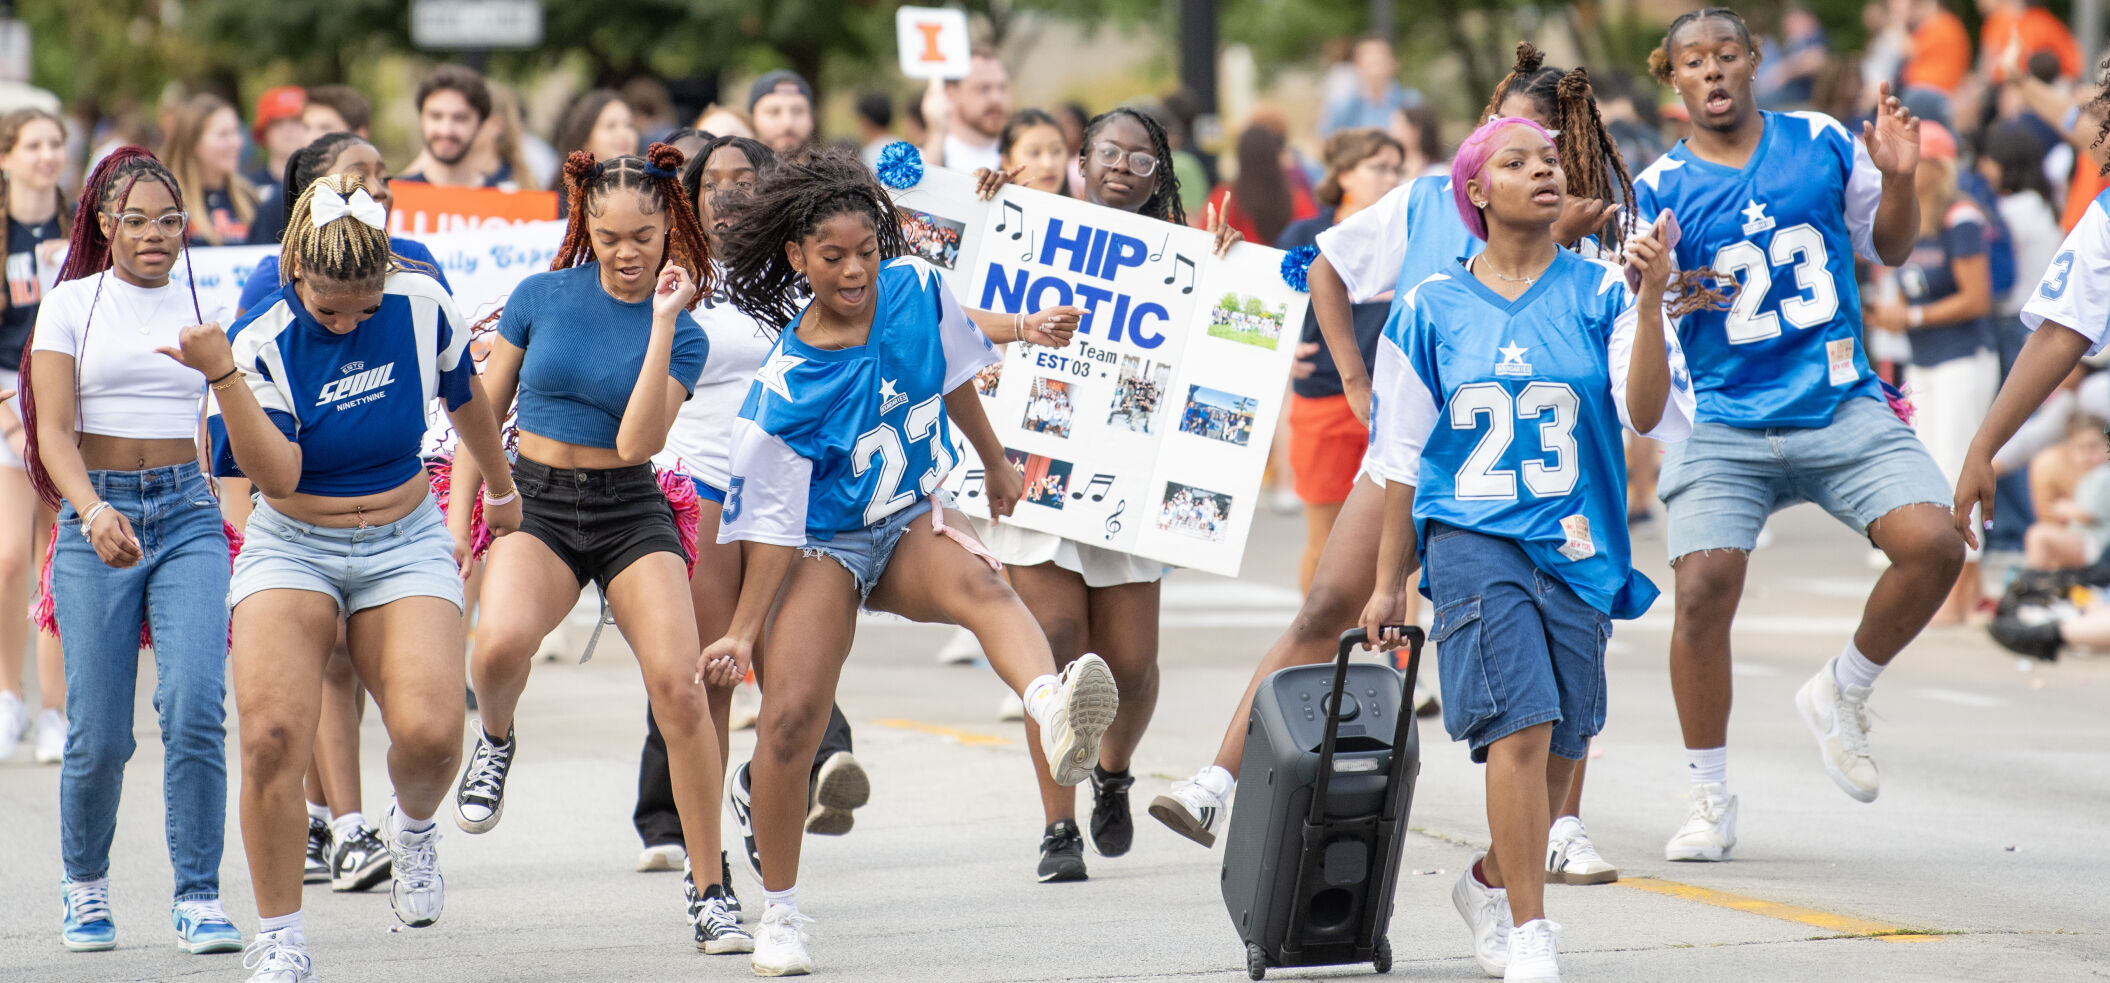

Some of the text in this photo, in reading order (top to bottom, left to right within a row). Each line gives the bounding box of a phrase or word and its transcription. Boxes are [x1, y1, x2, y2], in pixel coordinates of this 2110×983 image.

[916, 23, 947, 62] I
[1039, 218, 1148, 282] HIP
[2039, 250, 2076, 301] 3
[1712, 213, 1839, 345] 23
[979, 262, 1170, 350] NOTIC
[1036, 352, 1069, 371] EST
[1079, 341, 1117, 364] Team
[336, 391, 386, 412] NINETYNINE
[851, 393, 953, 527] 23
[1449, 381, 1580, 500] 23
[722, 475, 745, 525] 3
